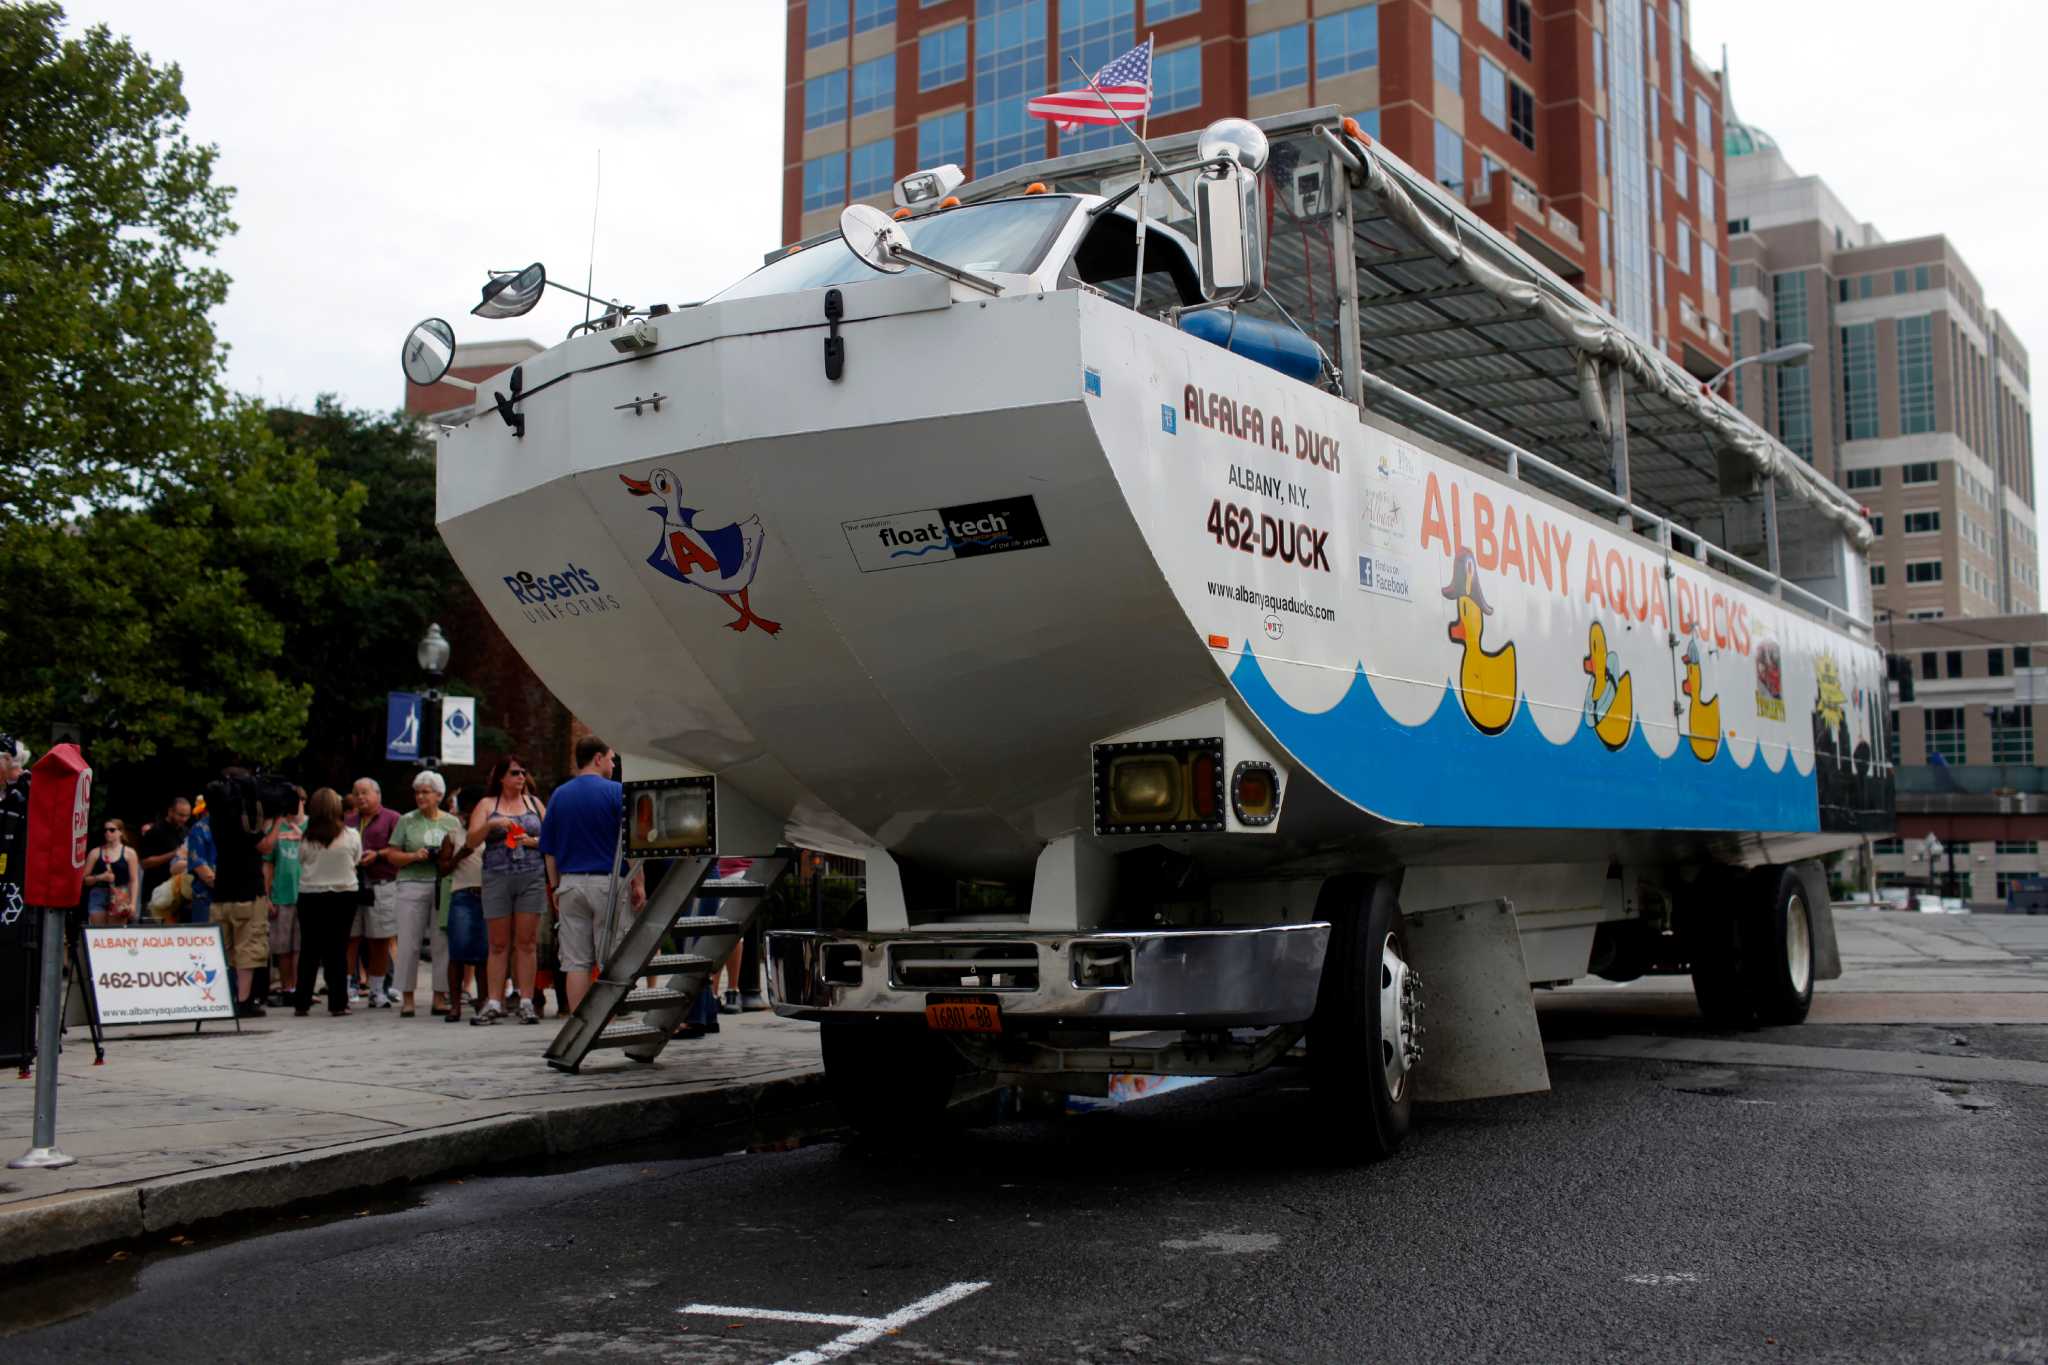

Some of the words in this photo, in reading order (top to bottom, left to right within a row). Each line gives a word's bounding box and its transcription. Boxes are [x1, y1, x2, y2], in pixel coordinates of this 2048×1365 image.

[1184, 383, 1265, 446] ALFALFA
[1271, 415, 1289, 454] A.
[1294, 424, 1341, 474] DUCK
[1228, 463, 1284, 505] ALBANY,
[1288, 487, 1310, 510] N.Y.
[879, 524, 942, 548] float
[948, 513, 1007, 538] tech
[1207, 498, 1331, 573] 462-DUCK
[670, 531, 720, 576] A
[1420, 471, 1572, 597] ALBANY
[1585, 539, 1667, 629] AQUA
[1677, 577, 1751, 657] DUCKS
[504, 563, 599, 604] Rosen's
[1207, 580, 1335, 622] www.albanyaquaducks.com
[1375, 573, 1409, 597] Facebook
[523, 595, 620, 624] UNIFORMS
[93, 938, 138, 949] ALBANY
[142, 936, 173, 949] AQUA
[177, 936, 215, 948] DUCKS
[98, 971, 189, 989] 462-DUCK
[102, 1003, 230, 1018] www.albanyaquaducks.com
